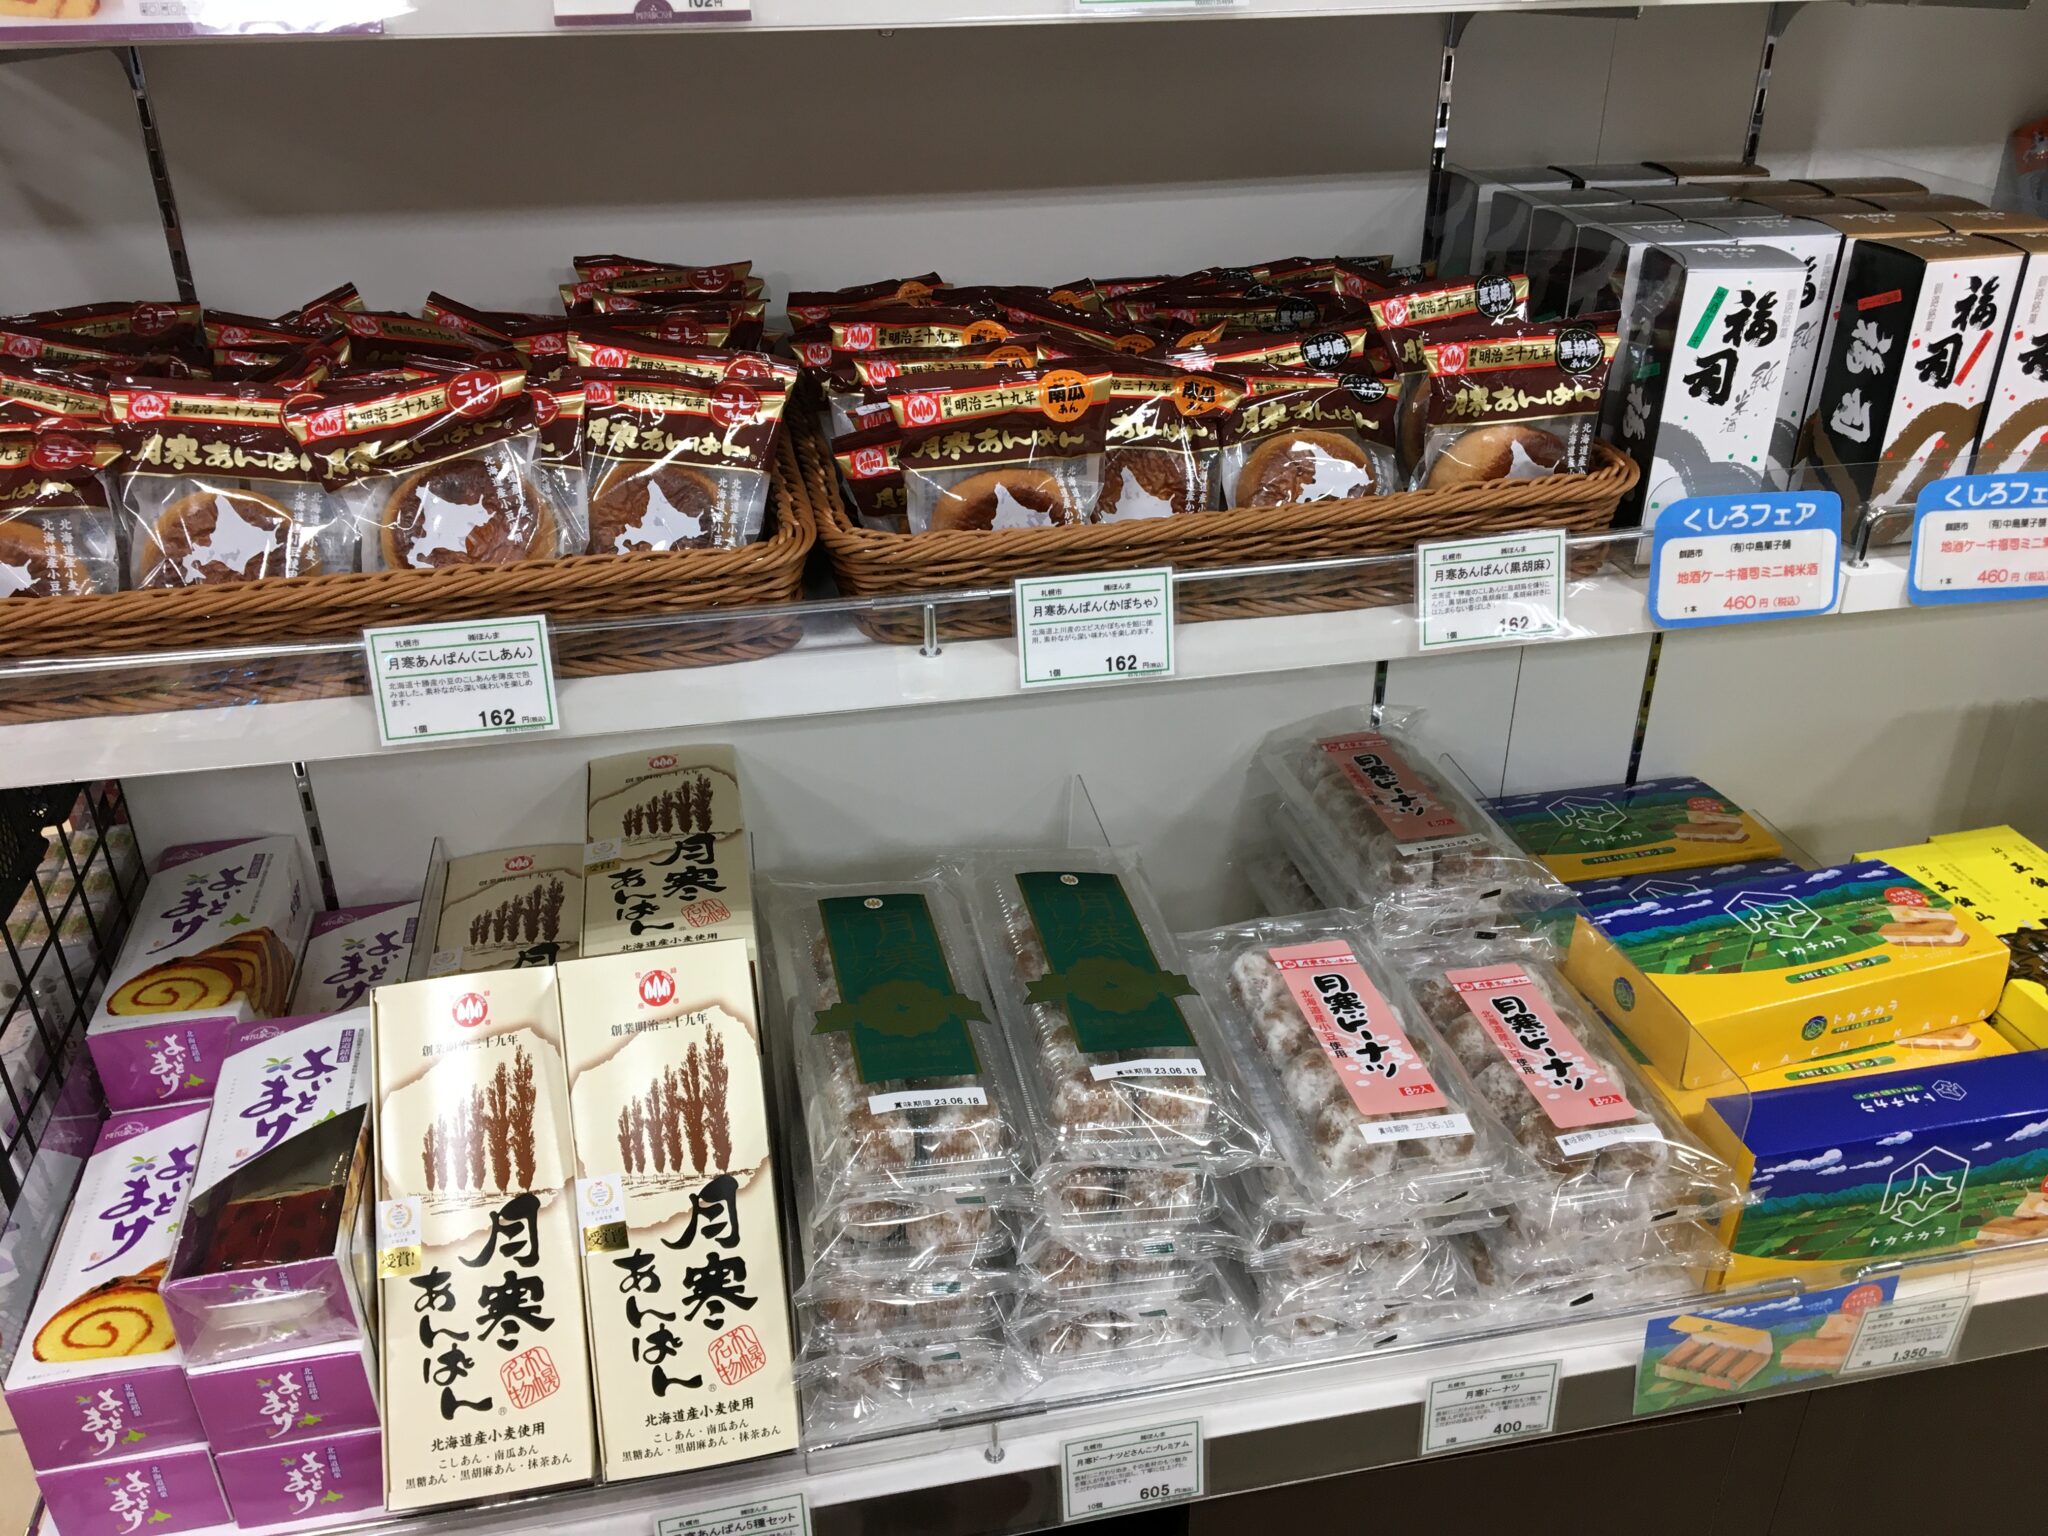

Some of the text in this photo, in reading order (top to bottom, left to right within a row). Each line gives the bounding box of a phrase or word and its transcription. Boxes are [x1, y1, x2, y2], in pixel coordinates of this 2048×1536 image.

[1417, 294, 1475, 315] 明治三十九年
[888, 329, 960, 345] 明治三十九年
[1303, 341, 1349, 358] 黒胡麻
[1478, 347, 1553, 364] 明治三十九年
[1559, 339, 1601, 360] 黒胡麻
[1569, 358, 1592, 368] あん
[456, 377, 491, 397] こし
[719, 391, 753, 409] こし
[954, 391, 1037, 413] 明治三十九年
[1057, 403, 1079, 414] あん
[1683, 502, 1817, 532] くしろフェア
[1977, 568, 2009, 584] 460
[1040, 587, 1063, 597] 札幌市
[1723, 594, 1757, 610] 460
[394, 638, 420, 649] 札幌市
[1105, 654, 1138, 672] 162
[413, 724, 428, 735] 1個
[478, 708, 516, 728] 162
[1580, 831, 1643, 846] トカチカラ
[649, 832, 727, 903] 月寒
[1777, 935, 1848, 958] トカチカラ
[1833, 999, 1900, 1025] トカチカラ
[611, 1012, 709, 1037] 創業明治三十九年
[1312, 973, 1398, 1079] 月寒ドーナツ
[1491, 995, 1585, 1091] 月寒ドーナツ
[1154, 1065, 1199, 1077] 23.06.18
[934, 1096, 980, 1108] 23.06.18
[1869, 1225, 1947, 1248] トカチカラ
[381, 1251, 416, 1270] 受賞!
[661, 1174, 759, 1331] 月寒
[458, 1193, 556, 1352] 月寒
[613, 1248, 703, 1399] あんぱん
[409, 1265, 494, 1421] あんぱん
[1465, 1383, 1521, 1400] 月寒ドーナツ
[644, 1395, 756, 1428] 北海道産小麦使用
[430, 1421, 546, 1452] 北海道産小麦使用
[1493, 1420, 1522, 1435] 400
[1139, 1484, 1171, 1500] 605
